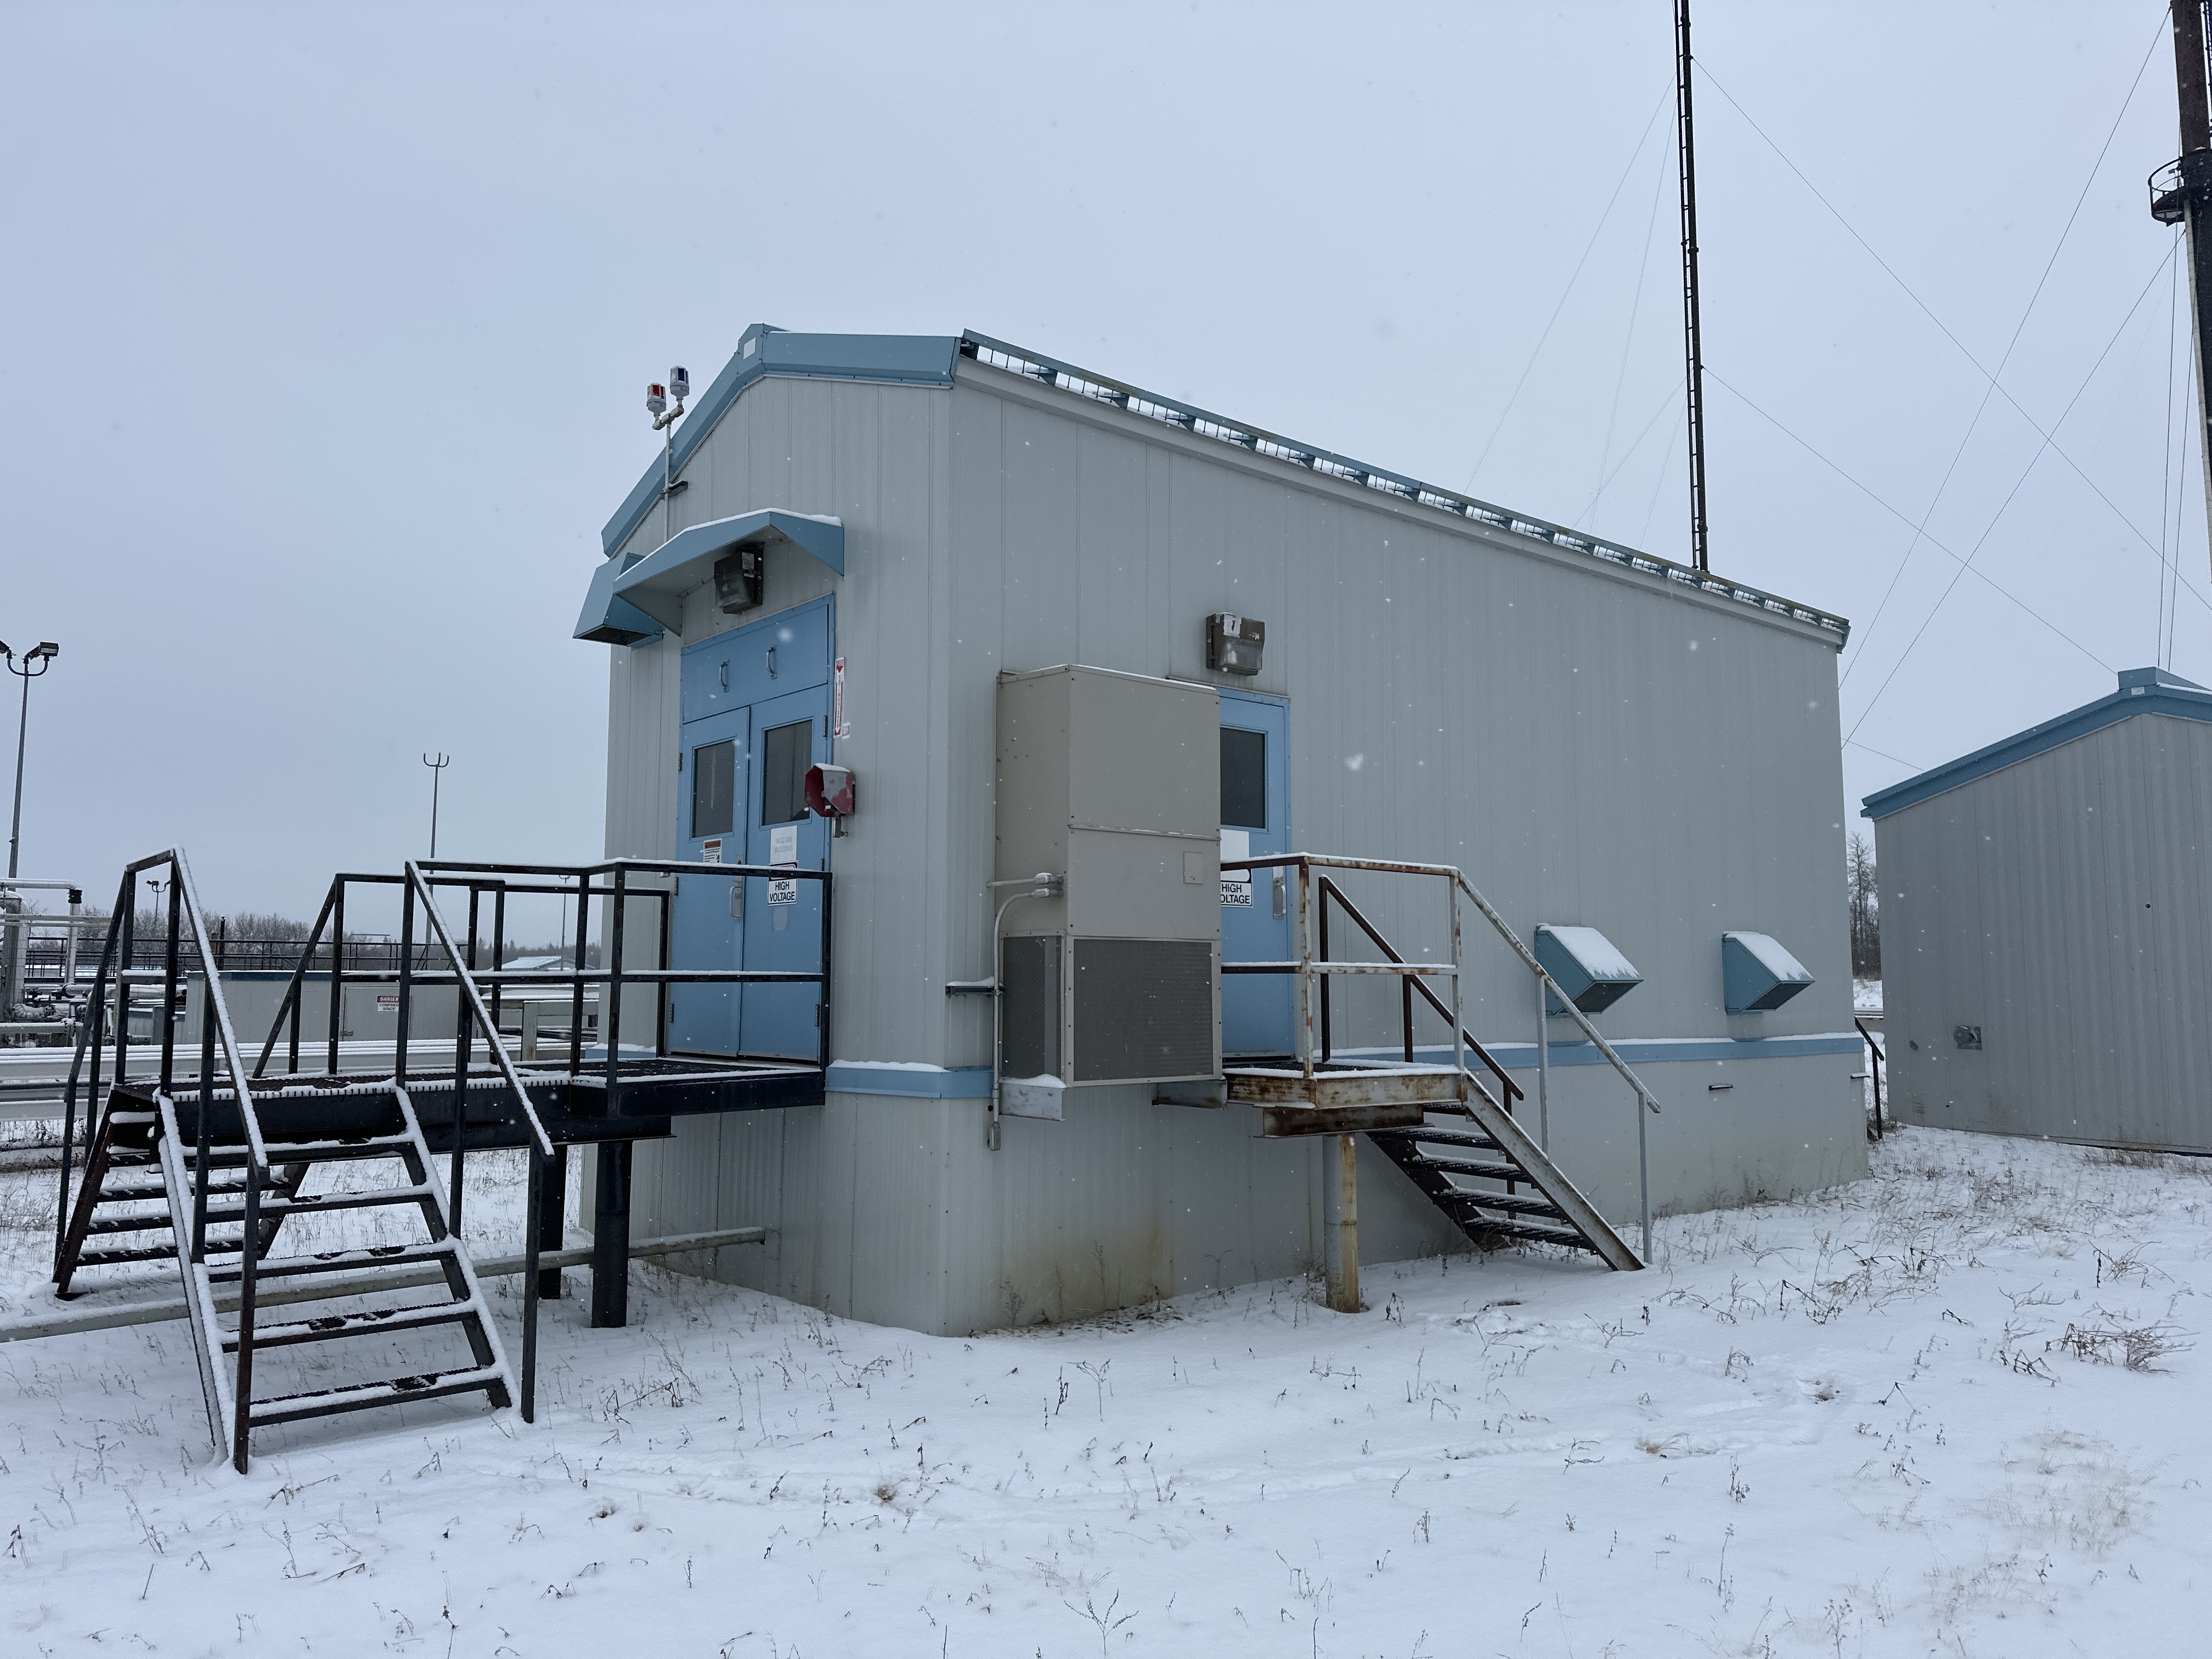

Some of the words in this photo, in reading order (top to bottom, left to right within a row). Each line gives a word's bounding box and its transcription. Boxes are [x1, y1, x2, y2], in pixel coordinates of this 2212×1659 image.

[775, 881, 790, 891] HIGH
[1221, 883, 1242, 893] HIGH
[769, 891, 795, 902] VOLTAGE
[1221, 894, 1250, 904] OLTAGE
